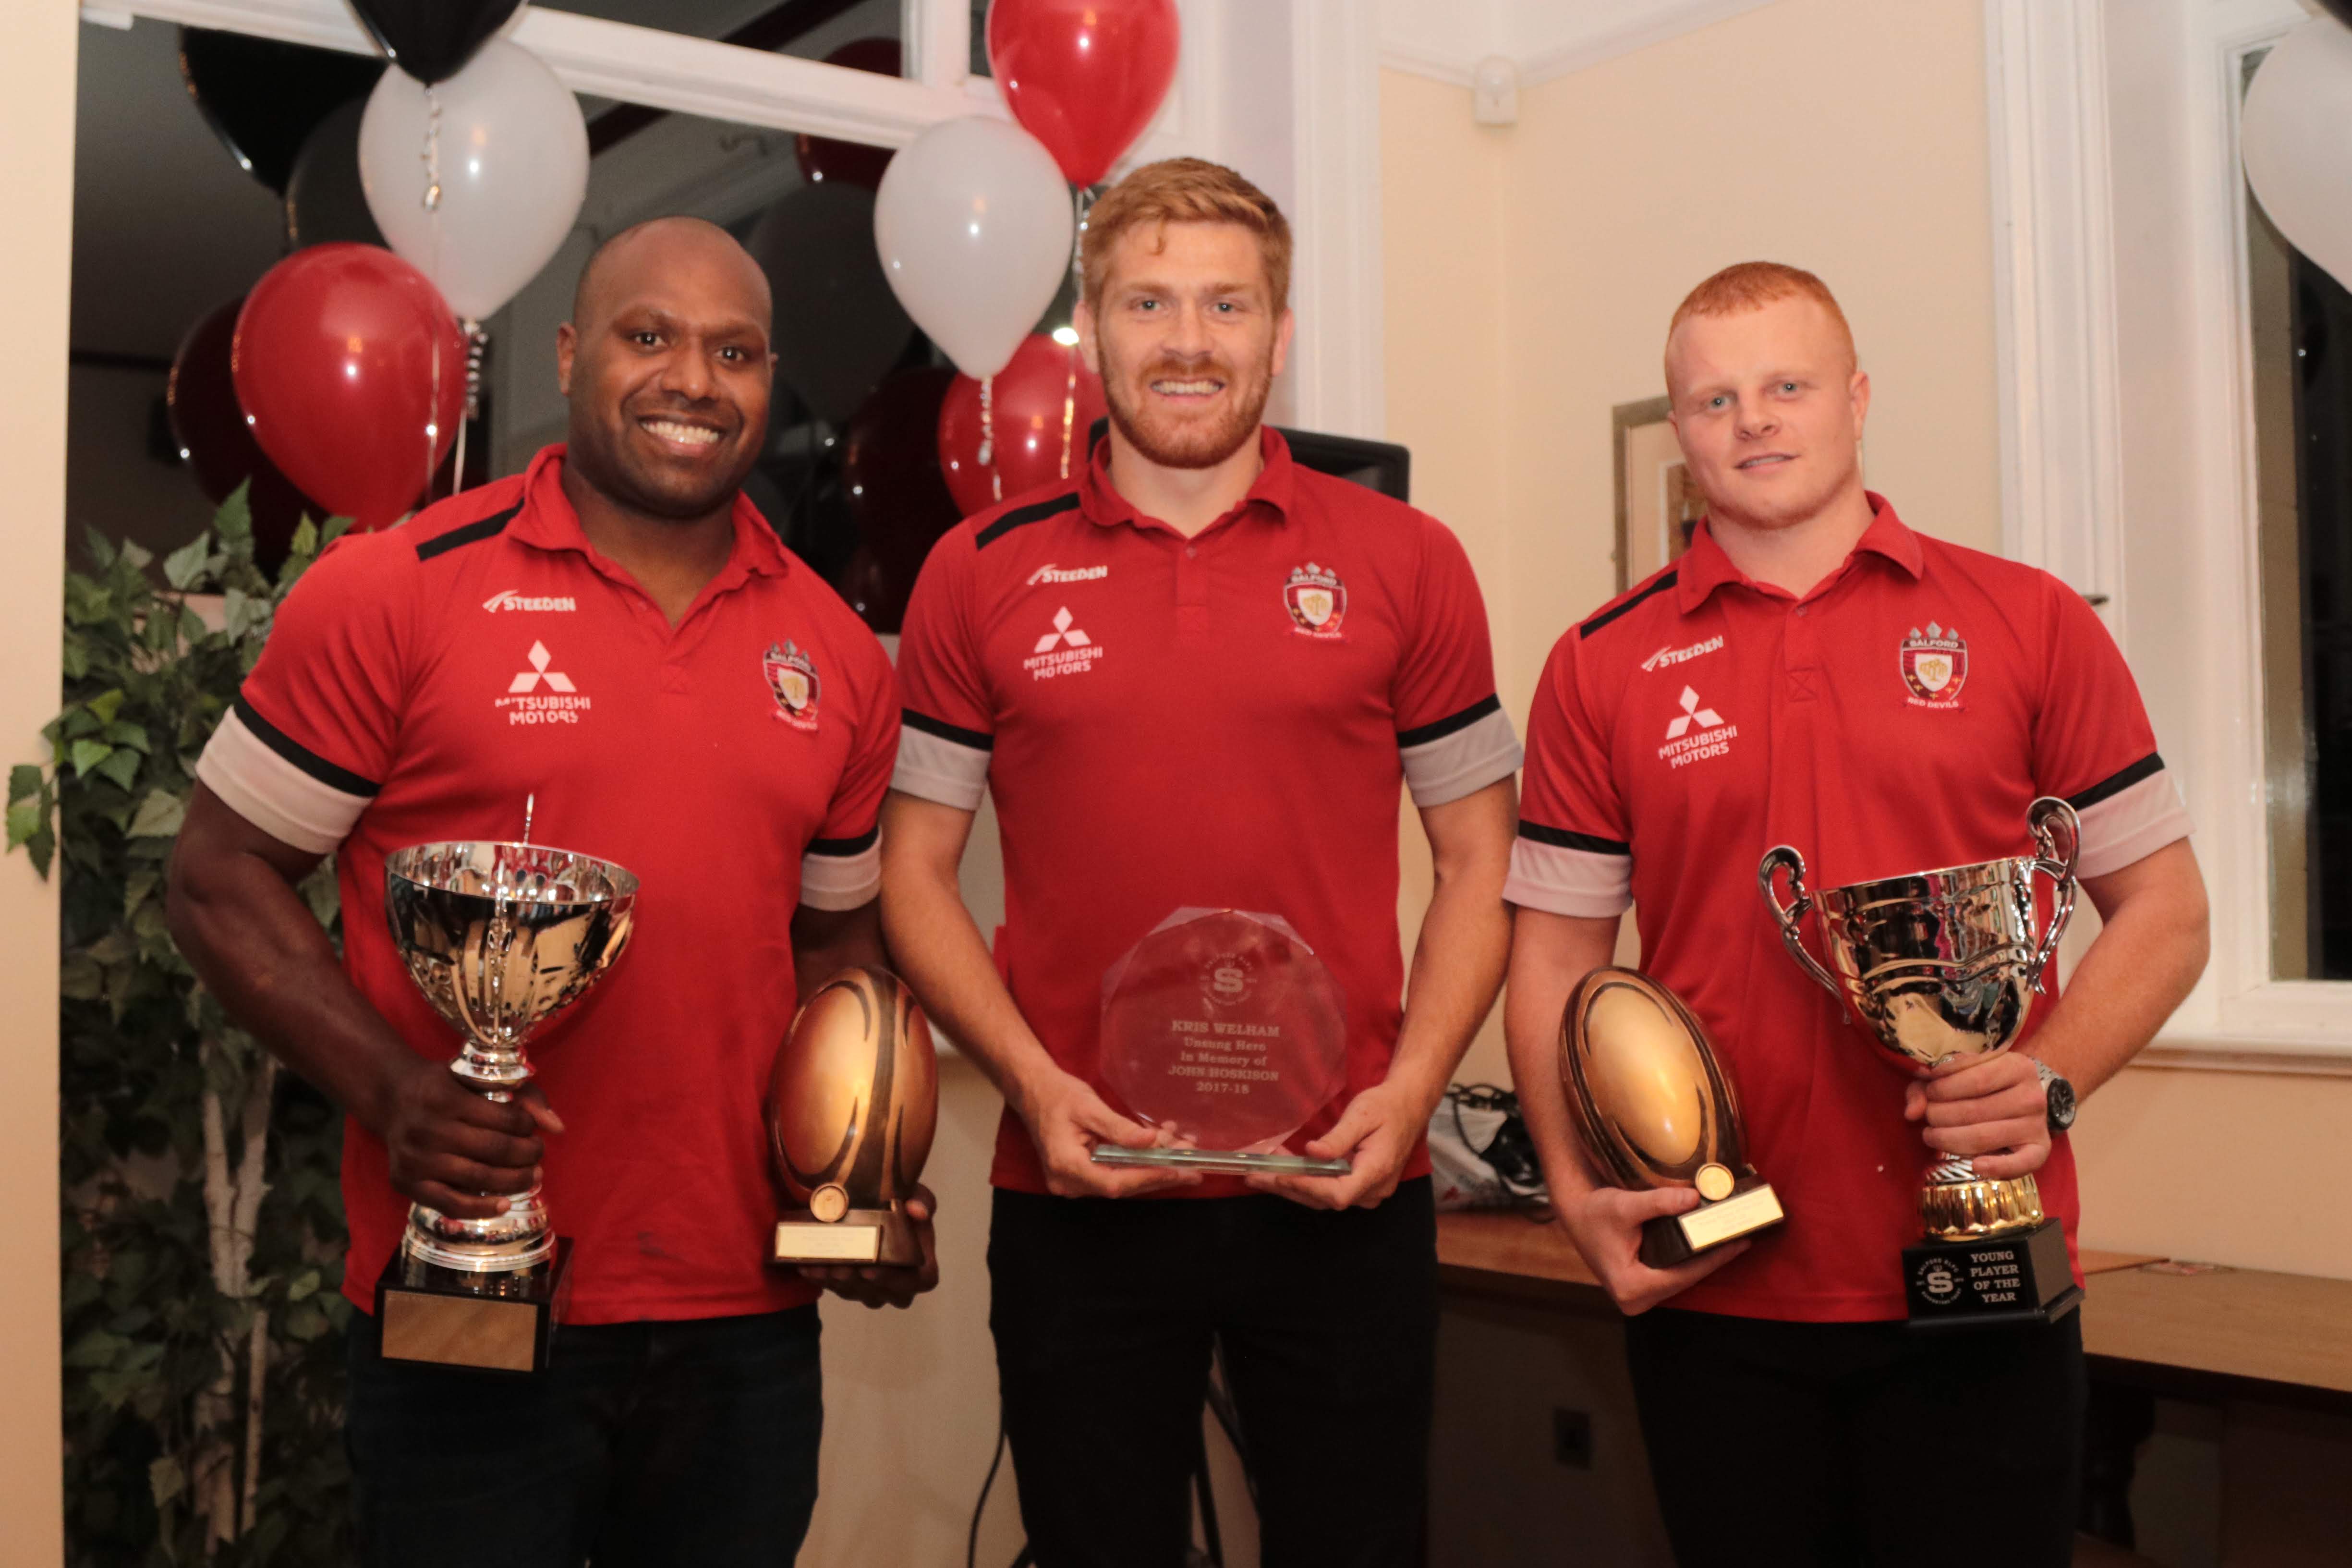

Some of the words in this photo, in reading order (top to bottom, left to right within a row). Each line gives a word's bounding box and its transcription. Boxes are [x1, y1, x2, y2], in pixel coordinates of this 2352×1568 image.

[1042, 565, 1107, 583] STEEDEN
[504, 596, 576, 611] STEEDEN
[1660, 635, 1723, 668] STEEDEN
[1910, 639, 1959, 649] SALFORD
[1024, 646, 1103, 670] MITSUBISHI
[1034, 660, 1091, 681] MOTORS
[1908, 697, 1926, 706] RED
[1659, 725, 1737, 760] MITSUBISHI
[1671, 741, 1729, 769] MOTORS
[1172, 1020, 1209, 1033] KRIS
[1213, 1022, 1280, 1037] WELHAM
[1184, 1037, 1232, 1051] Unsung
[1236, 1040, 1266, 1051] Hero
[1180, 1051, 1194, 1062] In
[1198, 1052, 1249, 1068] Memory
[1253, 1056, 1268, 1066] of
[1168, 1065, 1205, 1077] JOHN
[1197, 1082, 1249, 1094] 2017-18
[1970, 1251, 2014, 1263] YOUNG
[1970, 1264, 2019, 1277] PLAYER
[1927, 1271, 1953, 1293] S
[1974, 1280, 1990, 1290] OF
[1994, 1278, 2021, 1288] THE
[1982, 1292, 2016, 1303] YEAR
